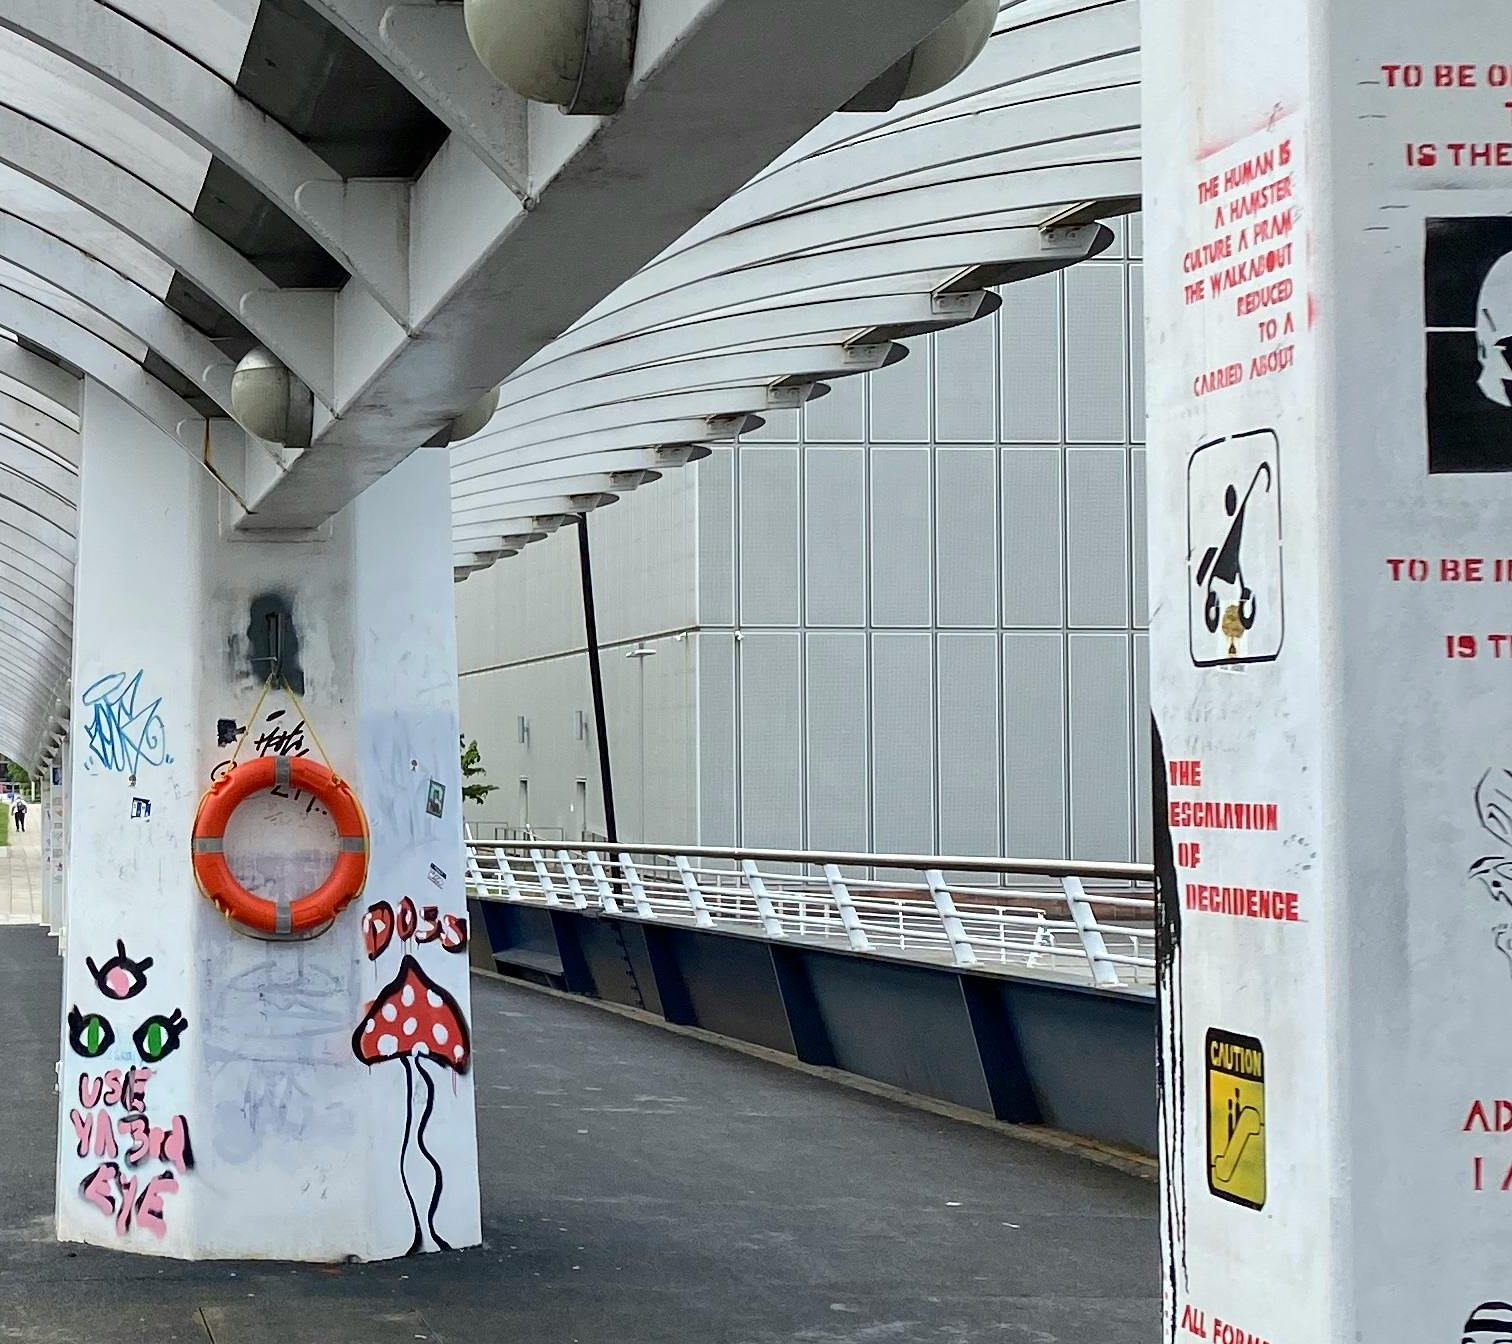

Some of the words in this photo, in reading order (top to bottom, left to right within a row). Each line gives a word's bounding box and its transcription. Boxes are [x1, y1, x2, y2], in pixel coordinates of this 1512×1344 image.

[1381, 65, 1423, 87] TO
[1434, 65, 1477, 87] BE
[1487, 64, 1512, 87] O
[1197, 175, 1219, 205] THE
[1224, 149, 1274, 192] HUMAN
[1278, 139, 1292, 167] IS
[1406, 143, 1437, 167] IS
[1446, 142, 1512, 167] THE
[1214, 206, 1225, 229] A
[1229, 175, 1293, 223] HAMSTER
[1183, 234, 1232, 274] CULTURE
[1237, 228, 1249, 253] A
[1253, 207, 1293, 246] PRAM
[1184, 279, 1205, 305] THE
[1210, 242, 1293, 300] WALKABOUT
[1237, 277, 1293, 317] REDUCED
[1258, 318, 1277, 343] TO
[1283, 311, 1294, 335] A
[1193, 362, 1243, 397] CARRIED
[1249, 344, 1295, 381] ABOUT
[1386, 559, 1429, 582] TO
[1440, 558, 1484, 582] BE
[1494, 559, 1512, 582] I
[1446, 635, 1477, 658] IS
[1487, 634, 1512, 658] T
[1169, 760, 1201, 787] THE
[1169, 801, 1279, 831] ESCALATION
[1178, 842, 1201, 869] OF
[1186, 883, 1299, 922] DECADENCE
[1210, 1040, 1262, 1077] CAUTION
[78, 1065, 156, 1114] USE
[1473, 1157, 1482, 1190] I
[78, 1161, 179, 1242] EYE
[1181, 1304, 1207, 1339] ALL
